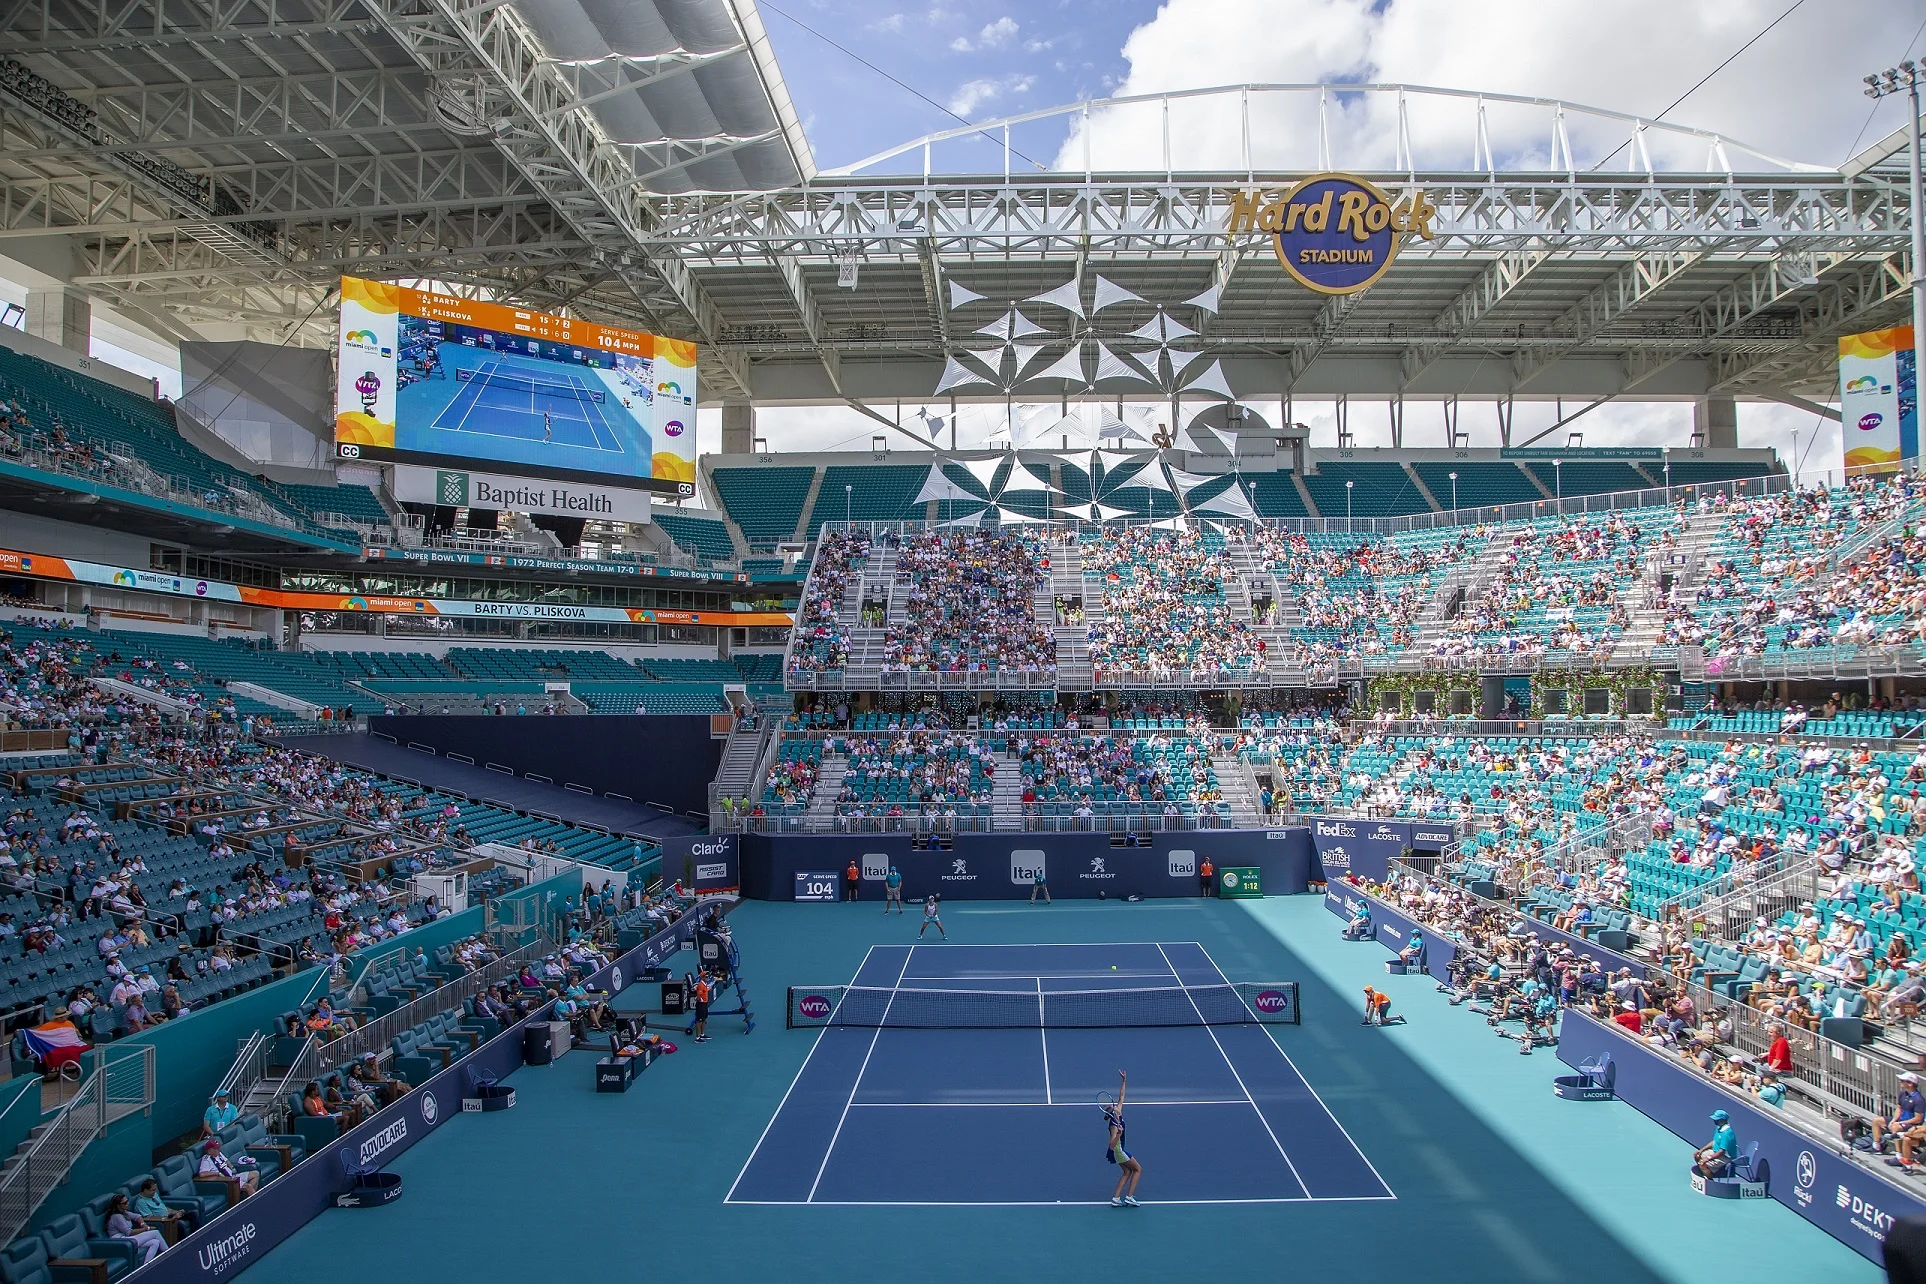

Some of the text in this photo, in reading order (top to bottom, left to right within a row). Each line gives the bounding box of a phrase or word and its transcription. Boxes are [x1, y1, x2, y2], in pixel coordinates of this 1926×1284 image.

[1229, 190, 1436, 241] Hard Rock
[1300, 249, 1373, 264] STADIUM
[434, 296, 460, 306] BARTY
[433, 308, 472, 321] PLISKOVA
[600, 328, 639, 340] SERVE SPEED
[598, 335, 640, 350] 104 MPH
[78, 359, 91, 370] 351
[1860, 418, 1881, 426] WTA
[342, 446, 358, 456] CC
[679, 484, 691, 493] CC
[476, 481, 613, 513] Baptist Health
[0, 554, 18, 563] open
[404, 552, 428, 560] SUPER
[431, 553, 454, 562] BOWL
[513, 558, 535, 567] 1972
[536, 560, 564, 569] PERFECT
[567, 562, 594, 571] SEASON
[596, 564, 615, 572] TEAM
[138, 573, 171, 585] miami open
[691, 571, 709, 579] BOWL
[475, 603, 585, 618] BARTY VS. PLISKOVA
[1317, 822, 1356, 837] FedEx
[1368, 833, 1401, 841] LACOSTE
[1415, 833, 1448, 842] ADVOCARE
[692, 842, 724, 855] Claro
[1322, 851, 1350, 861] BRITISH
[865, 866, 887, 877] Itaú
[1014, 866, 1043, 879] Itaú
[1171, 863, 1193, 873] Itaú
[807, 882, 833, 894] 104
[801, 1002, 829, 1012] WTA
[1256, 997, 1286, 1006] WTA
[464, 1102, 481, 1111] Itaú
[360, 1118, 406, 1163] ADVOCARE
[1692, 1181, 1703, 1191] aú
[1742, 1188, 1763, 1197] Itaú
[1852, 1196, 1895, 1231] DEKT
[199, 1223, 256, 1270] Ultimate
[214, 1245, 250, 1275] SOFTWARE
